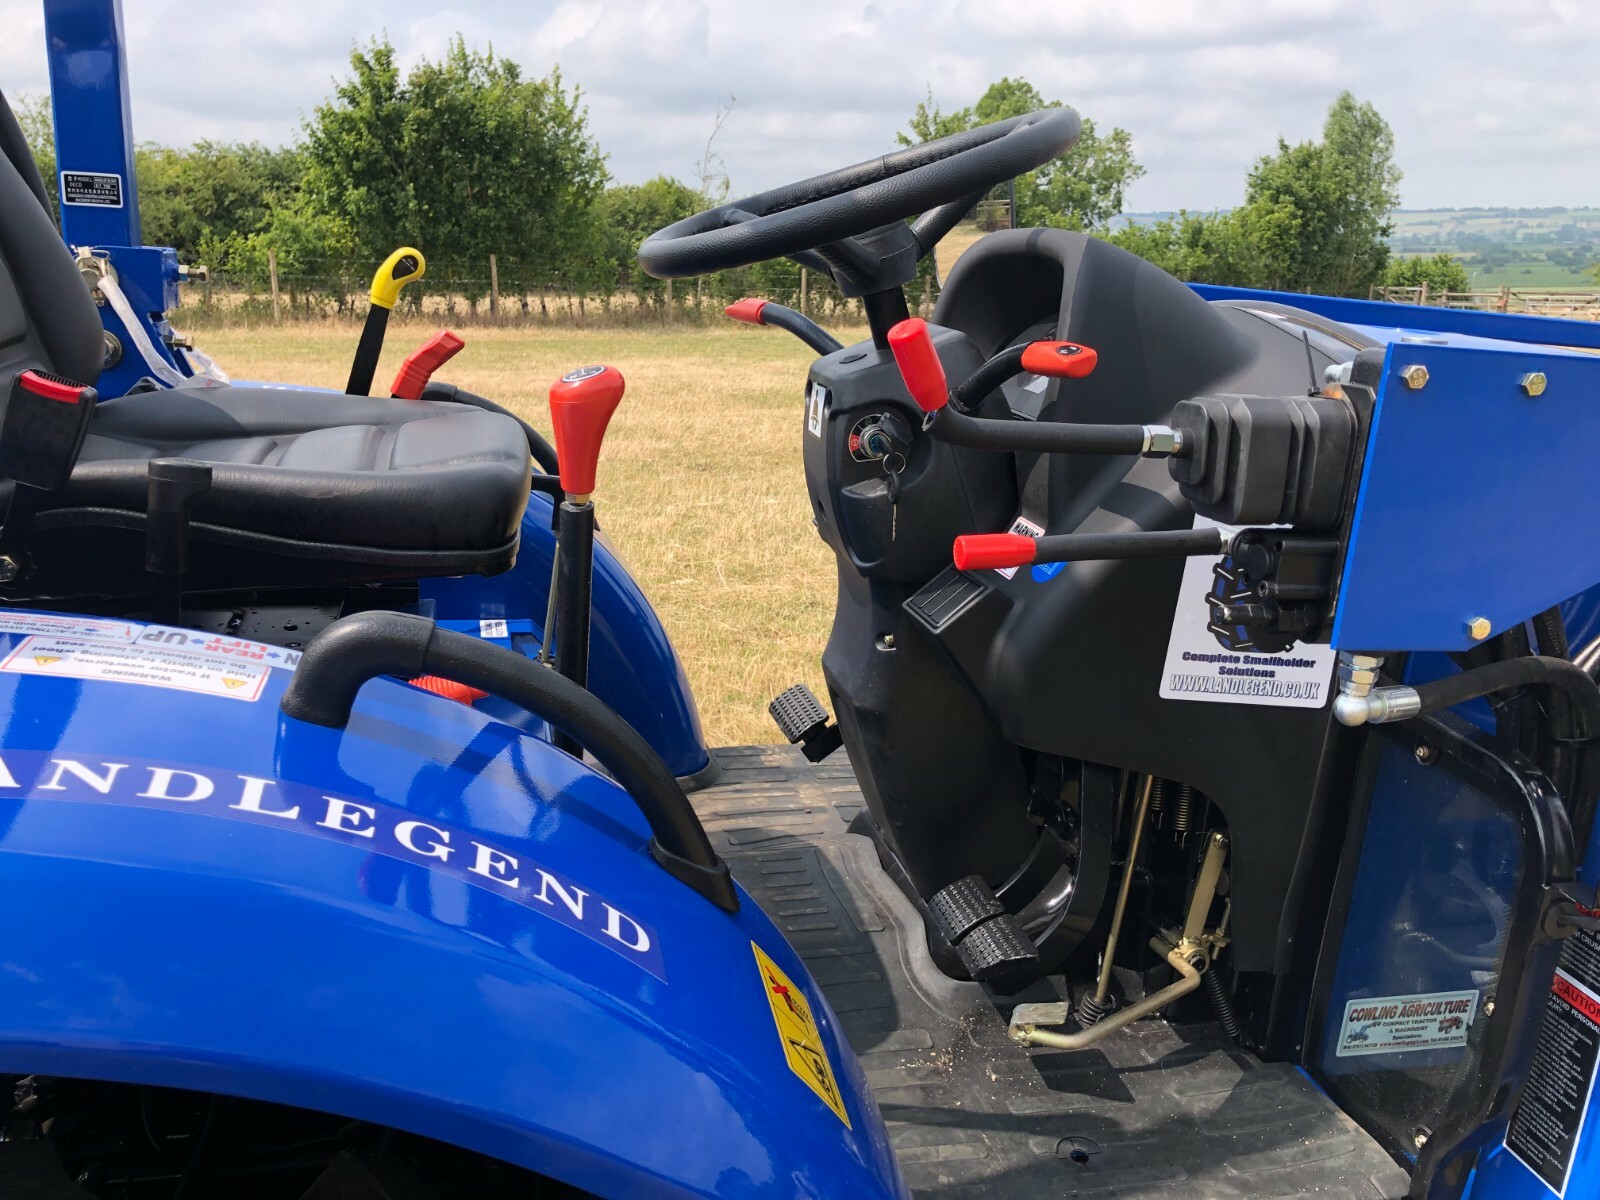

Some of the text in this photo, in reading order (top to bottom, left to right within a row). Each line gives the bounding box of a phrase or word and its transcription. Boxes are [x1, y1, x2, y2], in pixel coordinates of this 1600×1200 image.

[204, 644, 264, 660] REAR
[1182, 651, 1316, 668] Complete Smallholder
[101, 668, 172, 682] WARNING
[1218, 666, 1276, 678] Solutions
[1170, 674, 1320, 699] WWW.LANDLEGEND.CO.UK
[0, 755, 651, 952] NDLEGEND
[1349, 999, 1471, 1022] COWLING AGRICULTURE
